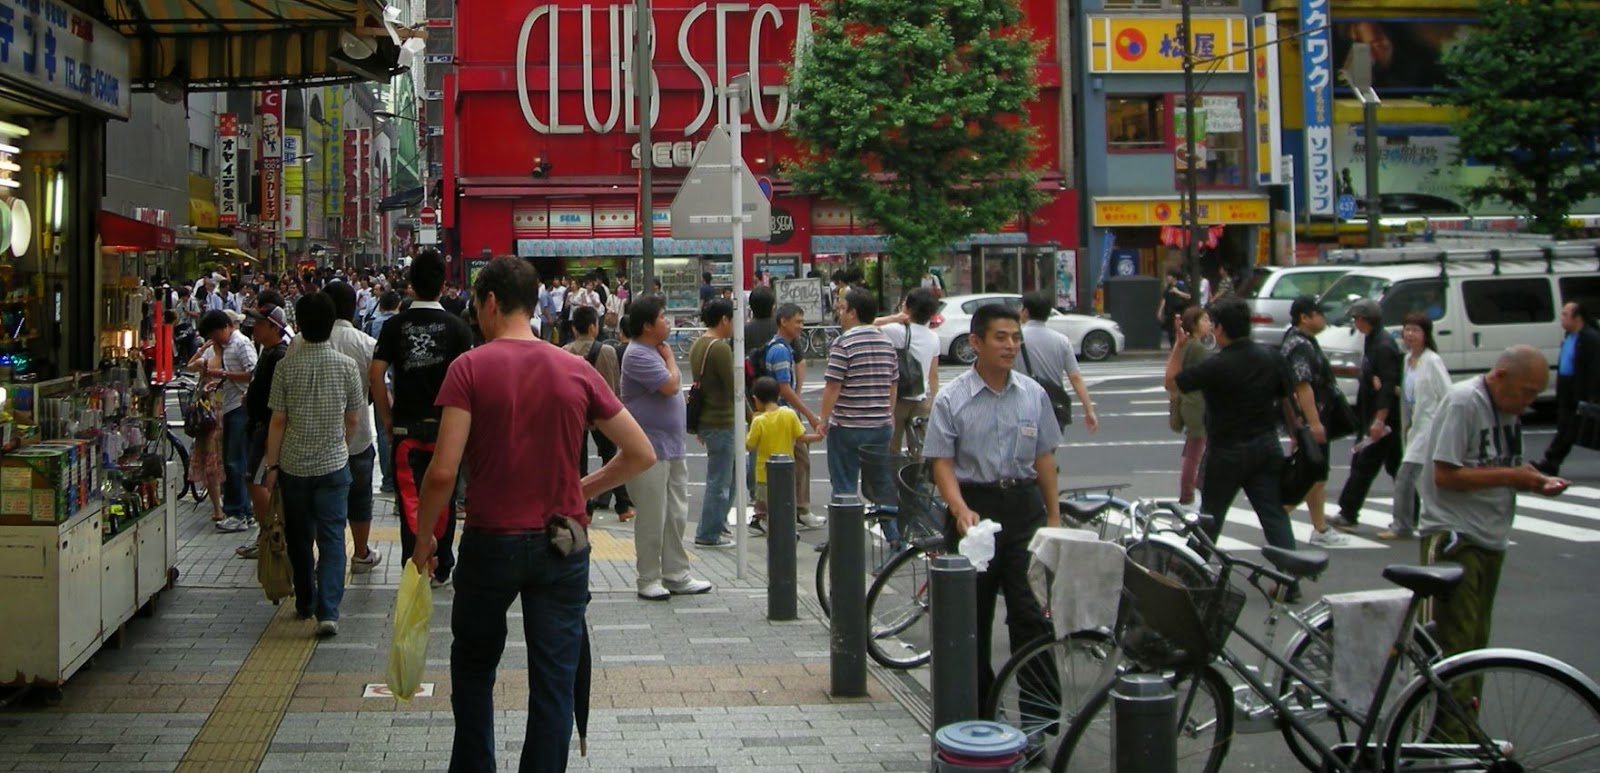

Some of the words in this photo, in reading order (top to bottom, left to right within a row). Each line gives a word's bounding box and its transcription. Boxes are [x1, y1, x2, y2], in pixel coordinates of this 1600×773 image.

[516, 4, 661, 134] CLUB
[222, 139, 235, 213] オヤイデ電気
[631, 140, 706, 168] EG
[1311, 137, 1329, 211] ソフマップ
[559, 214, 581, 223] SEGA
